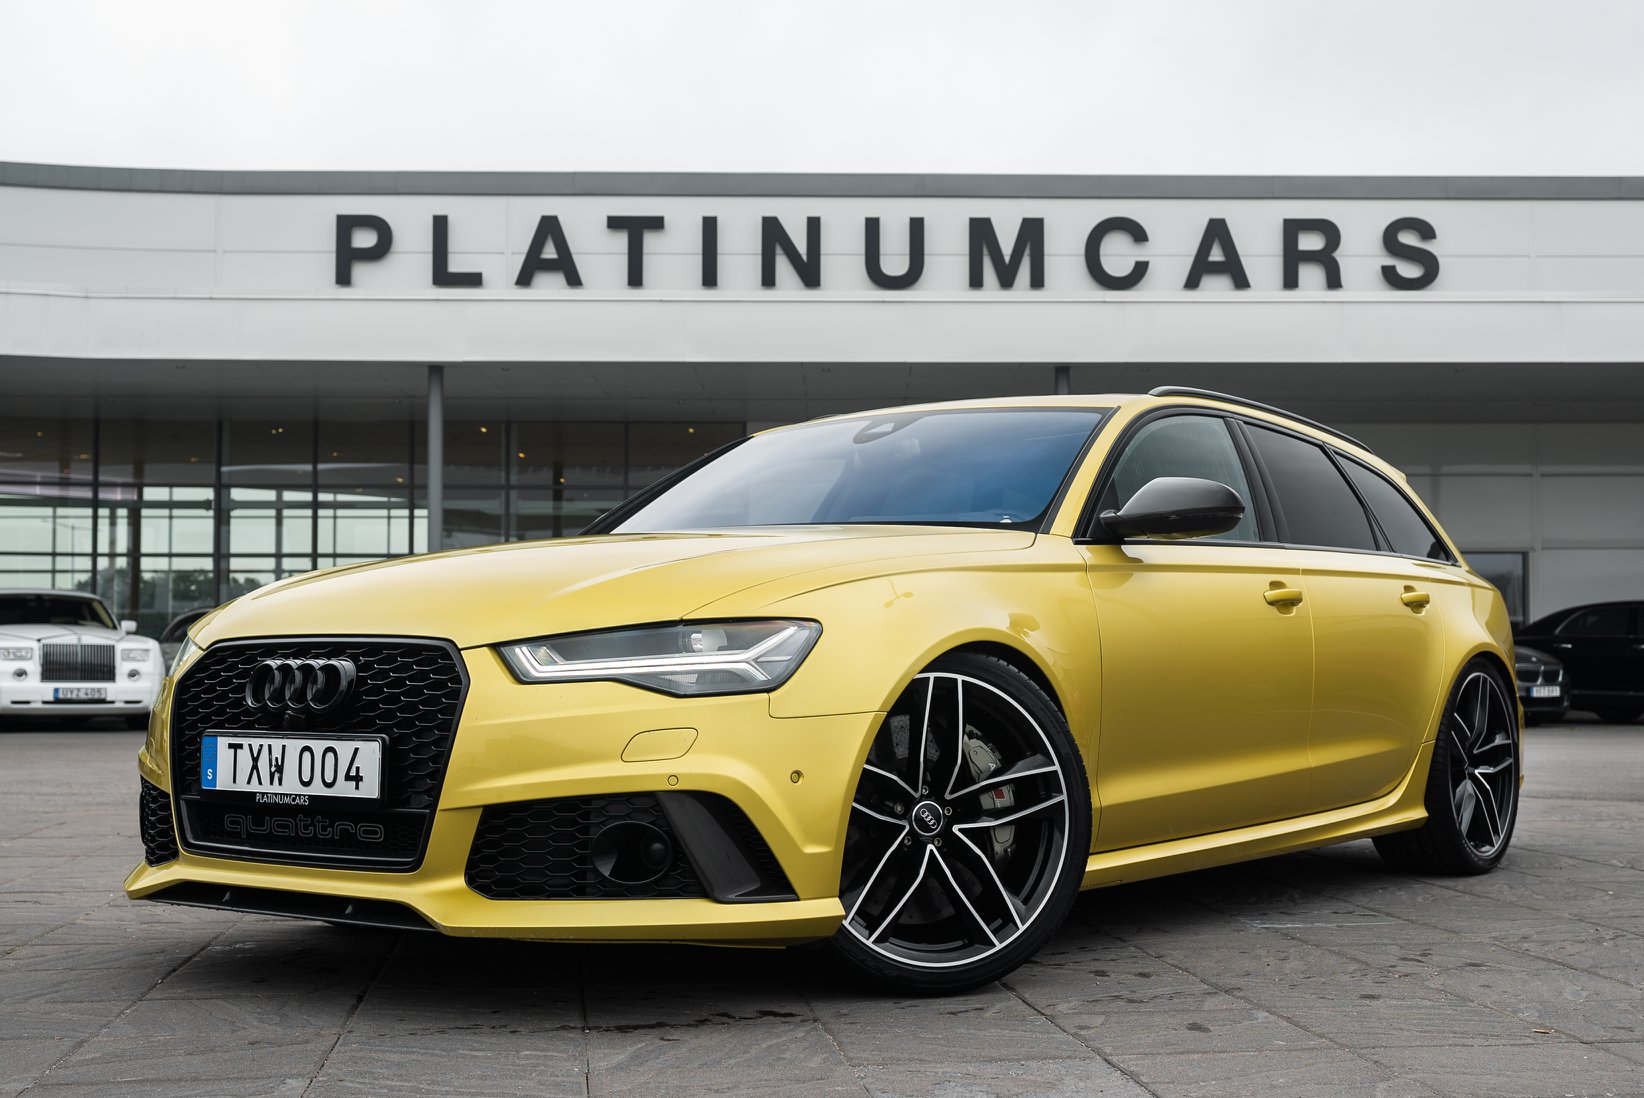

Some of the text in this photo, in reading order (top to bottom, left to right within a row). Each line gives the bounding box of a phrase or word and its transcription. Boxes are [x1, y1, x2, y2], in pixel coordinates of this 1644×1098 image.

[335, 214, 1440, 291] PLATINUMCARS
[207, 768, 213, 780] S
[227, 742, 364, 791] TXW 004
[255, 793, 309, 806] PLATINUMCARS
[224, 813, 384, 842] quattro
